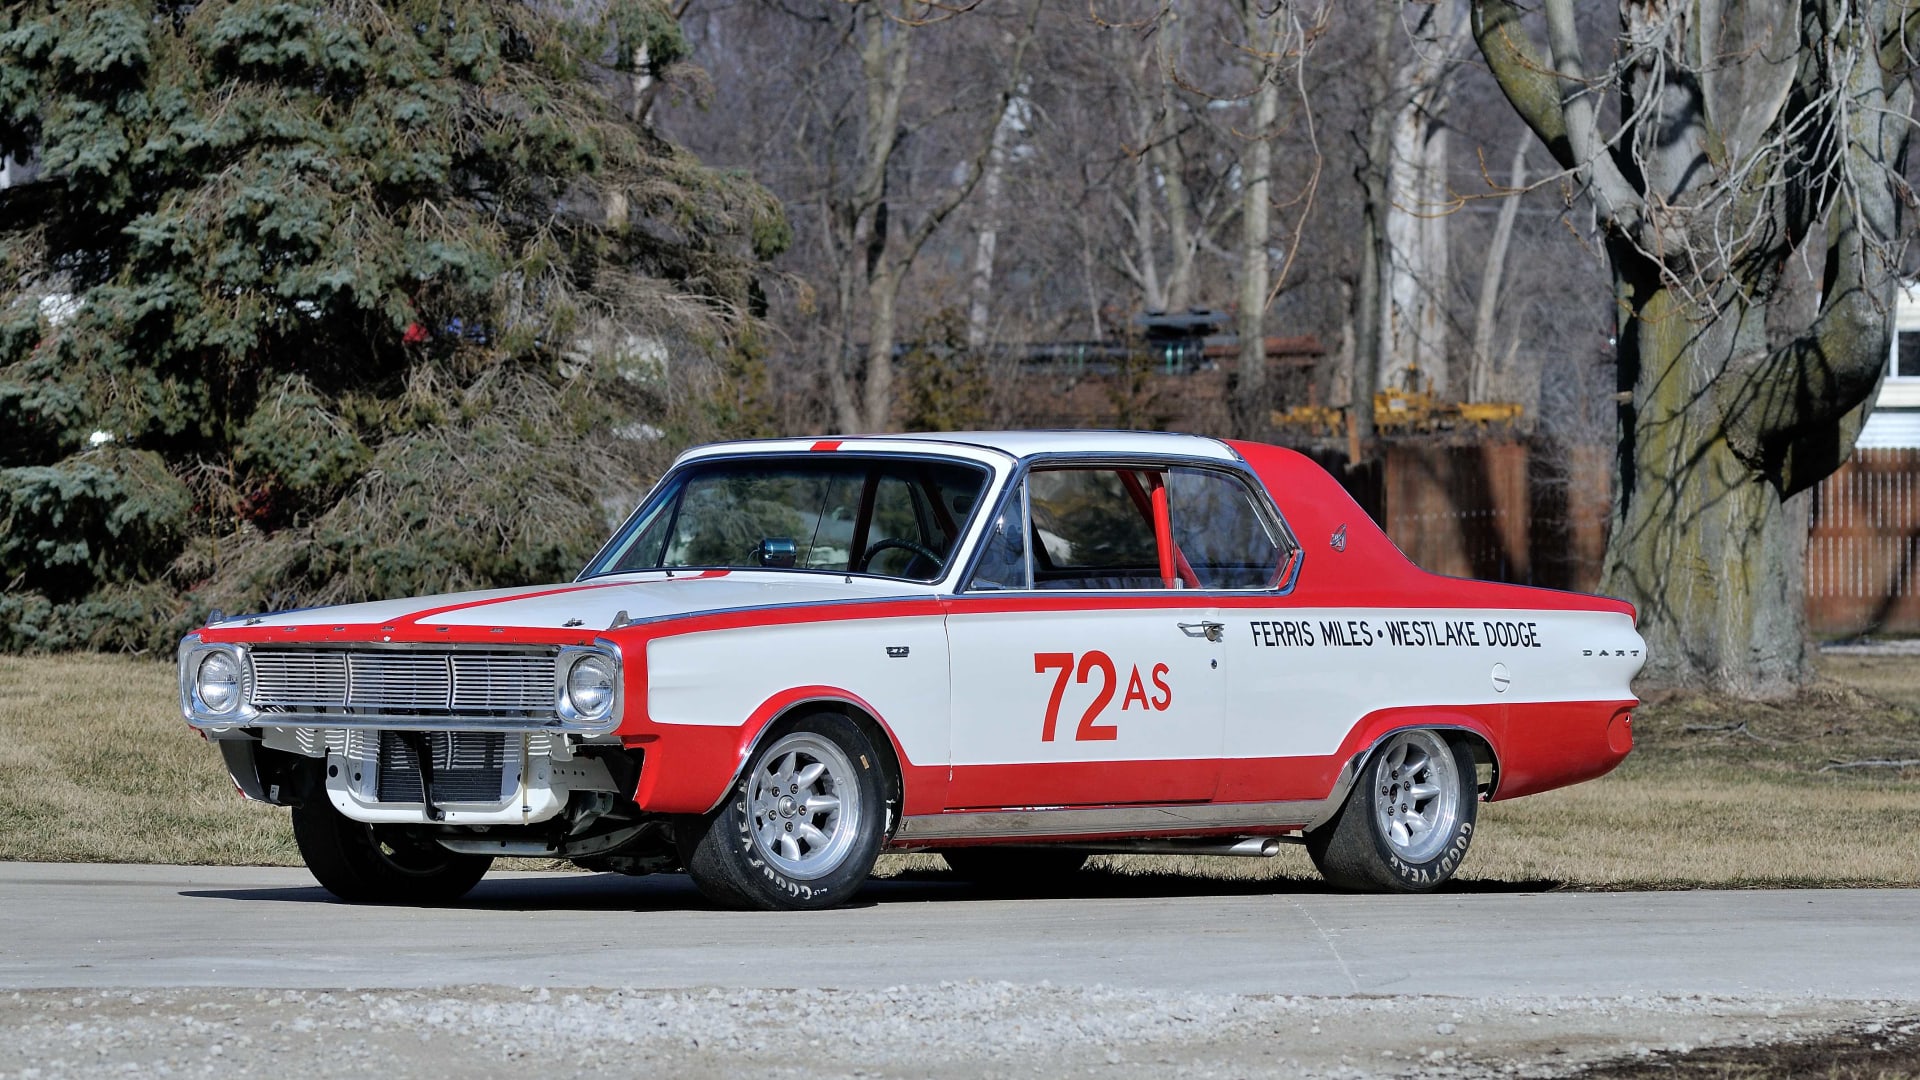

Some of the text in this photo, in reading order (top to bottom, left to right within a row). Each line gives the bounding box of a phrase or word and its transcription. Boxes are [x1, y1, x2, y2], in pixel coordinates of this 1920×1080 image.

[1250, 621, 1542, 647] FERRIS MILES WESTLAKE DODGE
[1582, 649, 1640, 657] DART
[1390, 822, 1472, 883] GOODYEAR
